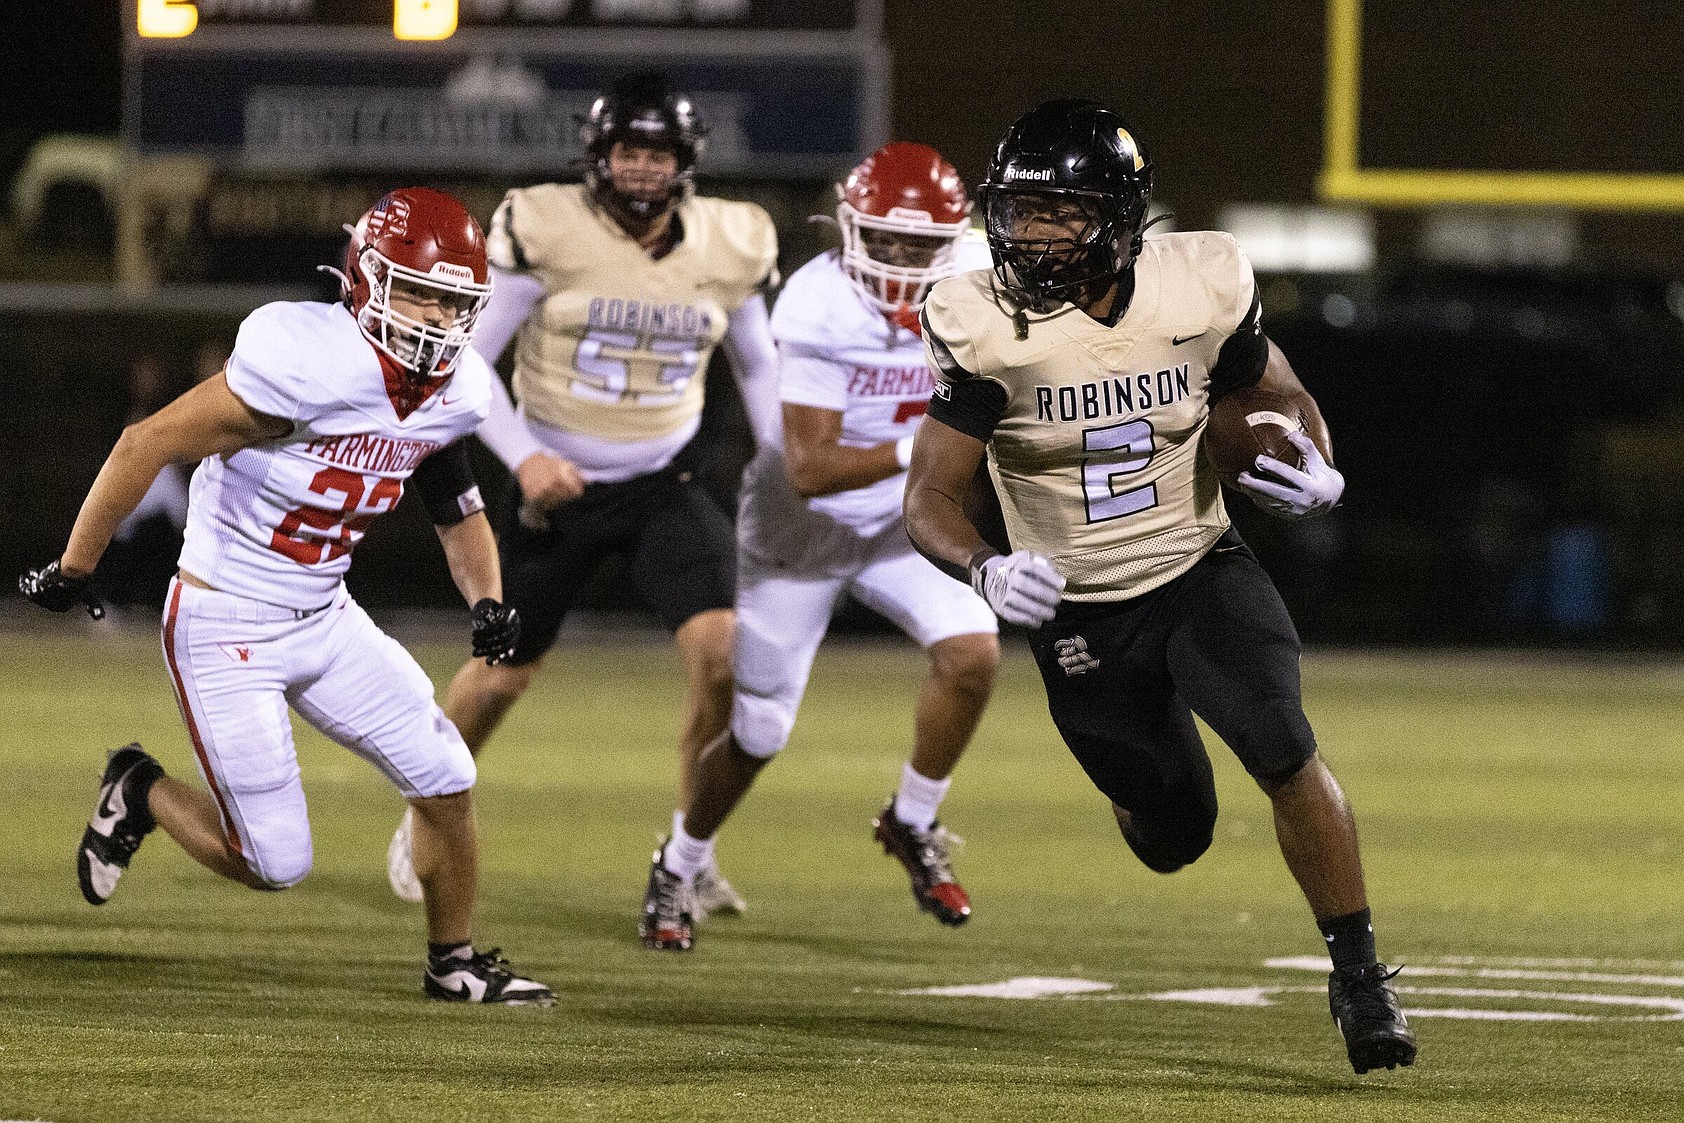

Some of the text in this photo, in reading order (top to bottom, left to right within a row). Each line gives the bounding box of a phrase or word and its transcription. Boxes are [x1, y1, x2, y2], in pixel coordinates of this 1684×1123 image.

[1005, 167, 1051, 181] Riddell
[1116, 127, 1145, 172] 2
[438, 264, 471, 279] Riddell
[588, 298, 712, 334] ROBINSON
[570, 331, 700, 406] 53
[1036, 362, 1190, 423] ROBINSON
[1081, 418, 1159, 525] 2
[270, 466, 402, 565] 22
